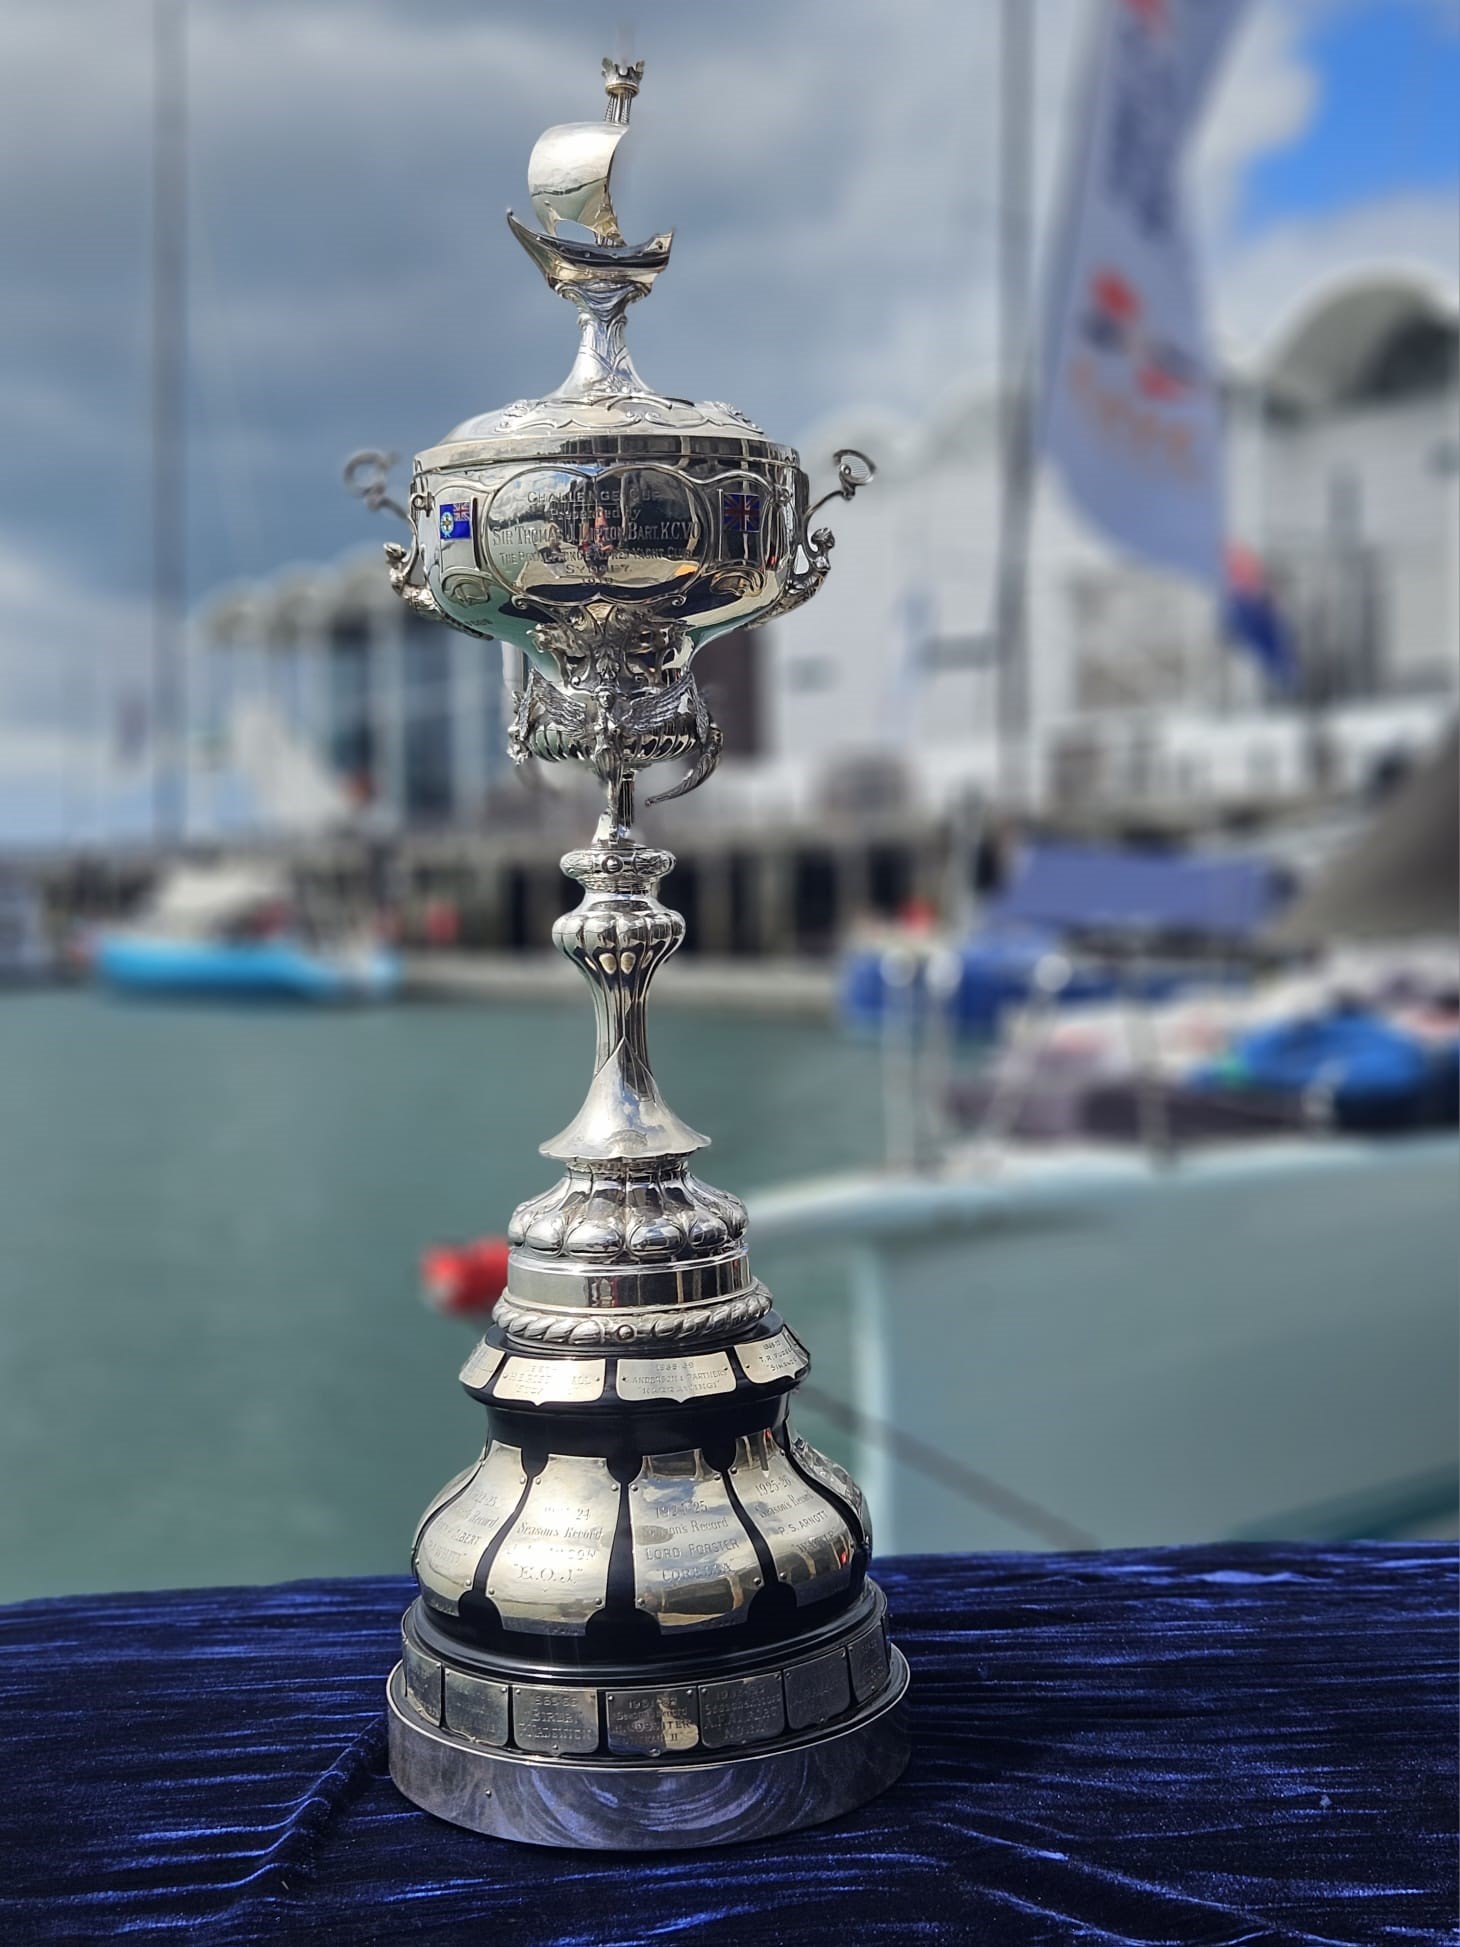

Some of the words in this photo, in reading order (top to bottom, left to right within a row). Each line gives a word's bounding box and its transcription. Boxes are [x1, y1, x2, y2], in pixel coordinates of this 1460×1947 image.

[492, 527, 513, 545] SIR
[798, 1509, 829, 1529] ARNOTT
[645, 1547, 682, 1561] LORD
[688, 1538, 740, 1556] FORSTER
